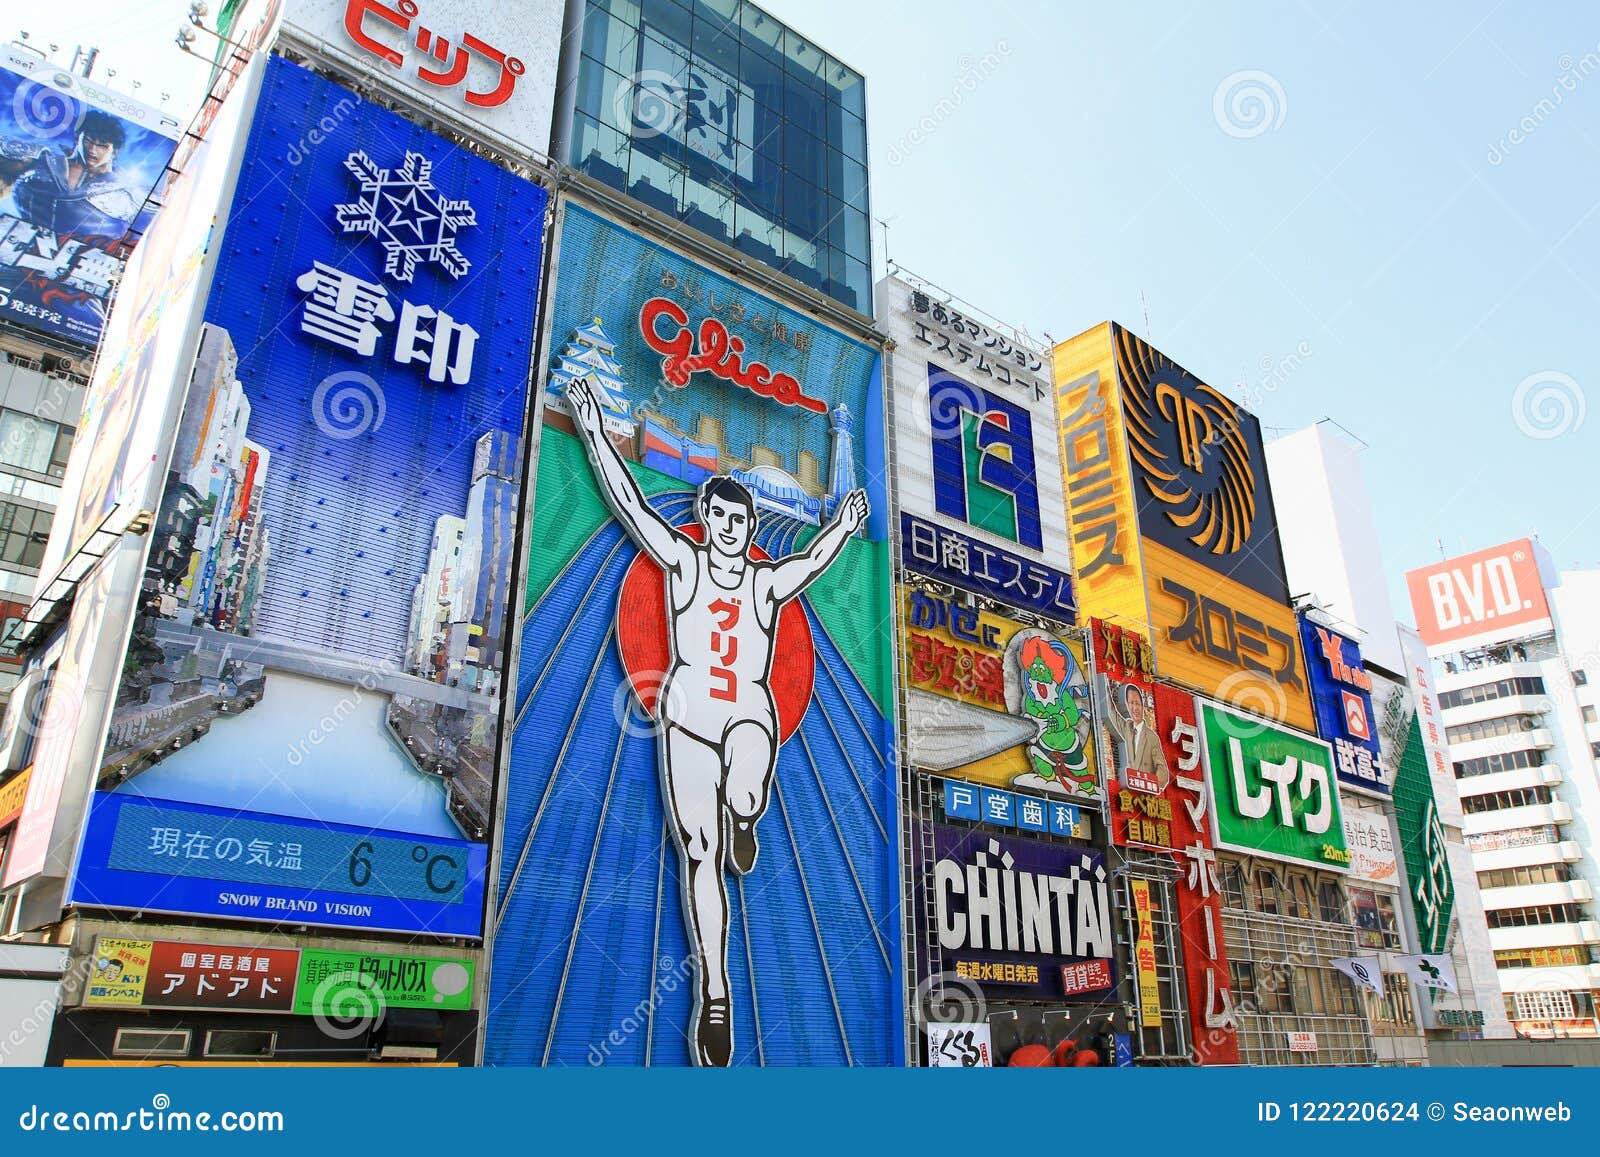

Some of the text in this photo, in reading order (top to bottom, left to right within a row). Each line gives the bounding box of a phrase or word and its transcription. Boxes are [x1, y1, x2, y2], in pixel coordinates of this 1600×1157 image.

[344, 0, 526, 108] ピップ
[296, 260, 480, 386] 雪印
[660, 268, 810, 352] おいしさと健康
[909, 290, 1043, 373] 夢あるマンション
[640, 297, 829, 415] Glico
[915, 320, 1047, 402] エステムコート
[1058, 368, 1126, 581] プロミス
[911, 519, 1081, 613] 日商エステム
[1427, 555, 1533, 631] B.V.D.
[707, 597, 742, 703] グリコ
[1161, 575, 1304, 695] プロミス
[1228, 736, 1332, 834] レイク
[1335, 737, 1391, 786] 武富士
[1118, 789, 1174, 821] 食べ放題
[147, 826, 303, 871] 現在の気温
[348, 841, 375, 888] 6
[935, 838, 1114, 959] CHINTAI
[1172, 715, 1239, 1028] タマホーム
[218, 891, 372, 918] SNOW BRAND VISION
[161, 972, 283, 999] アドアド
[181, 951, 271, 973] 個室居酒屋
[357, 956, 427, 993] ピタットハウス
[955, 960, 1039, 984] 毎週水曜日発売
[1089, 973, 1110, 987] ニュース
